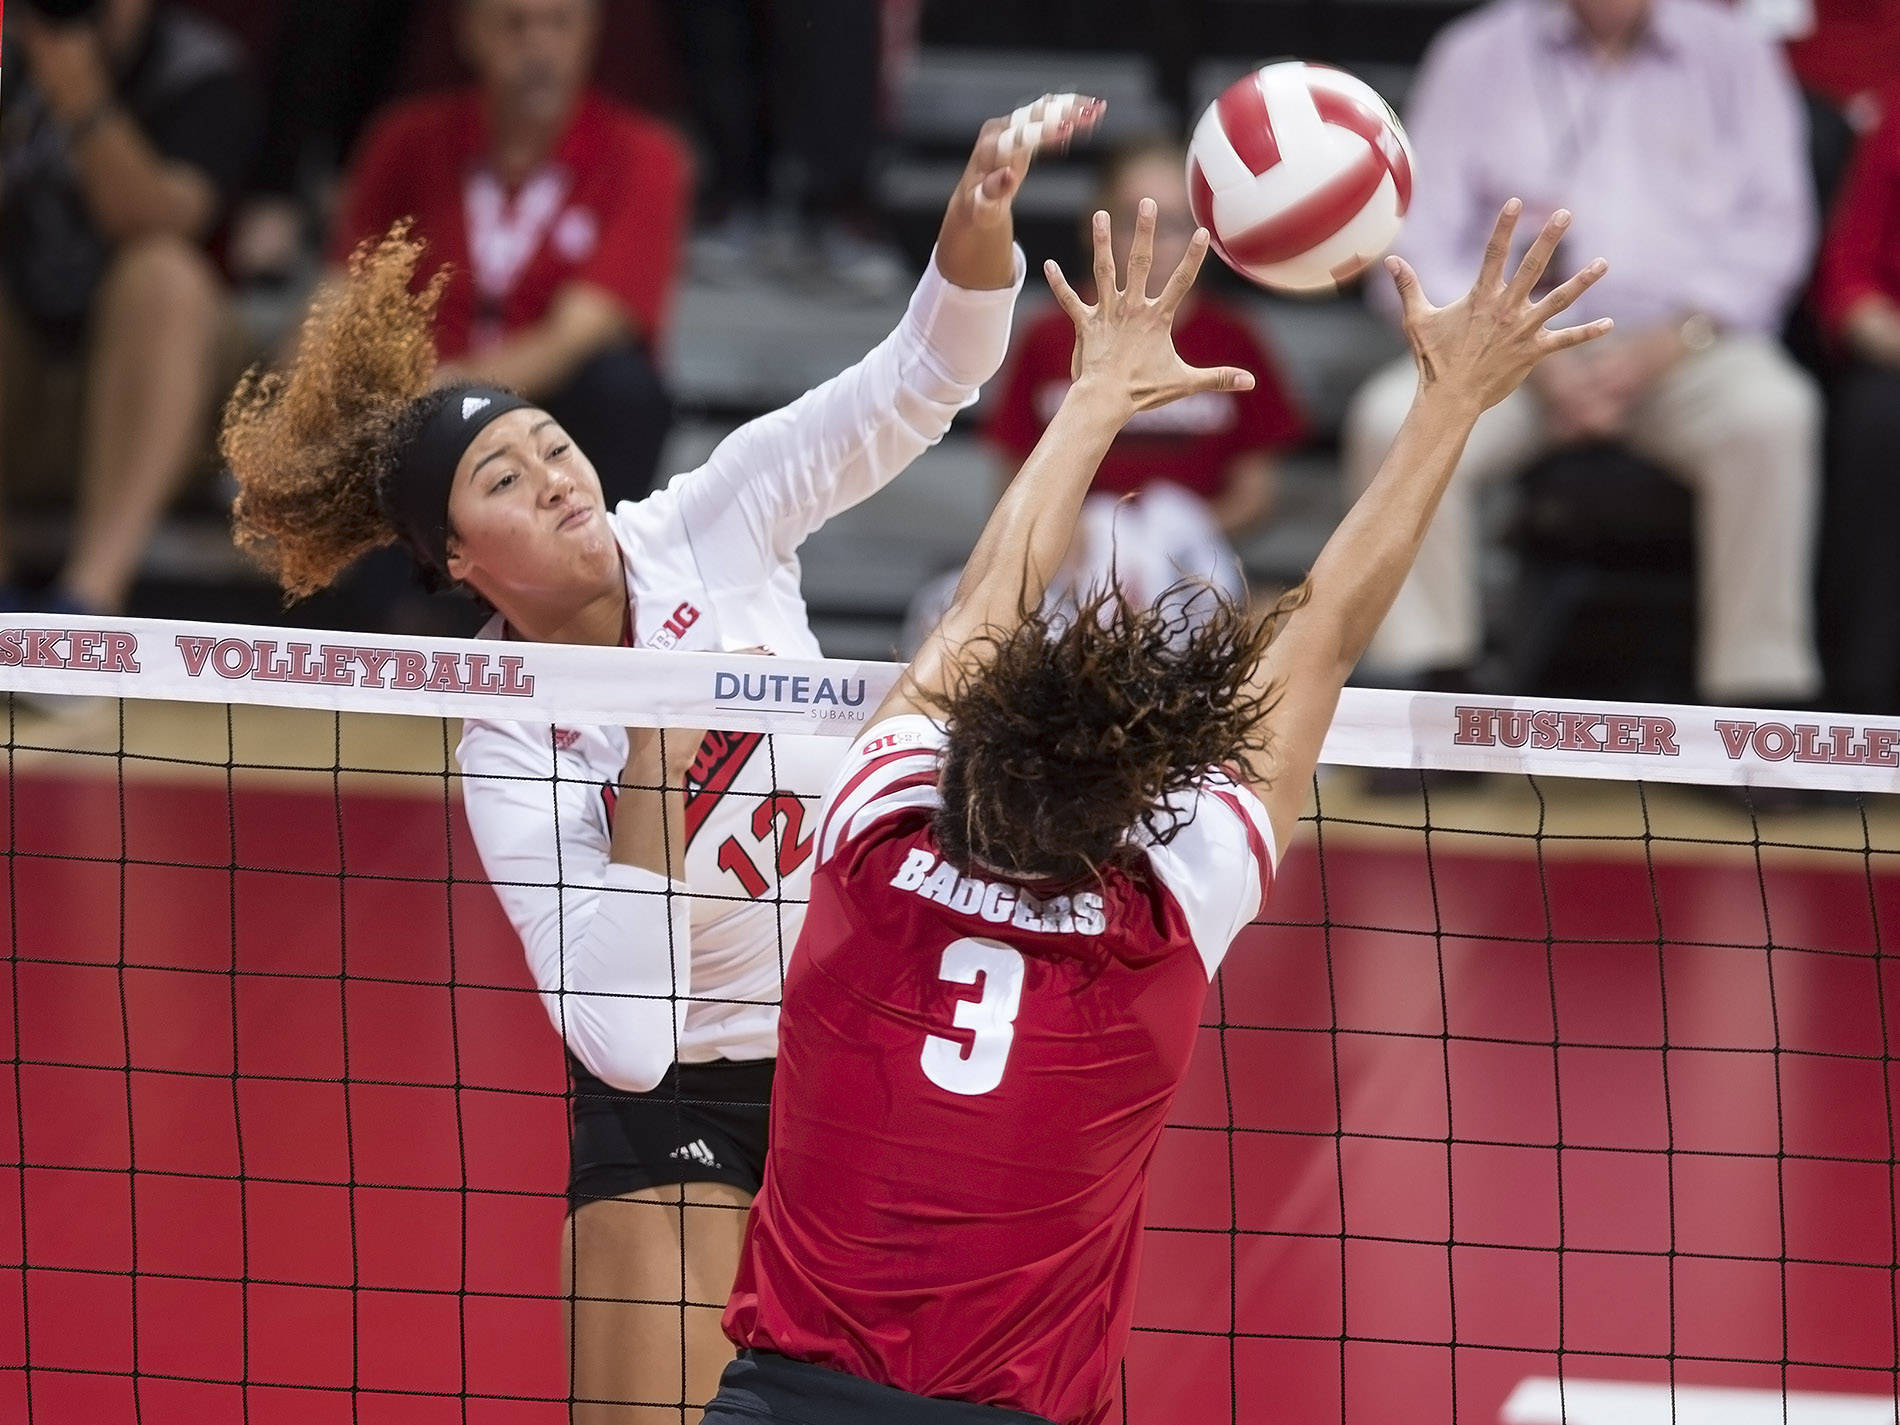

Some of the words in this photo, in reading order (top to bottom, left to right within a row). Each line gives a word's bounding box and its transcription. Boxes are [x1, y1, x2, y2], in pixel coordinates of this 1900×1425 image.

[0, 629, 141, 673] SKER
[175, 635, 535, 698] VOLLEYBALL
[714, 672, 866, 707] DUTEAU
[811, 709, 865, 721] SUBARU
[1454, 706, 1680, 756] HUSKER
[1715, 720, 1900, 767] VOLLE
[717, 790, 816, 900] 12
[889, 847, 1106, 935] BADGERS
[919, 936, 1025, 1095] 3
